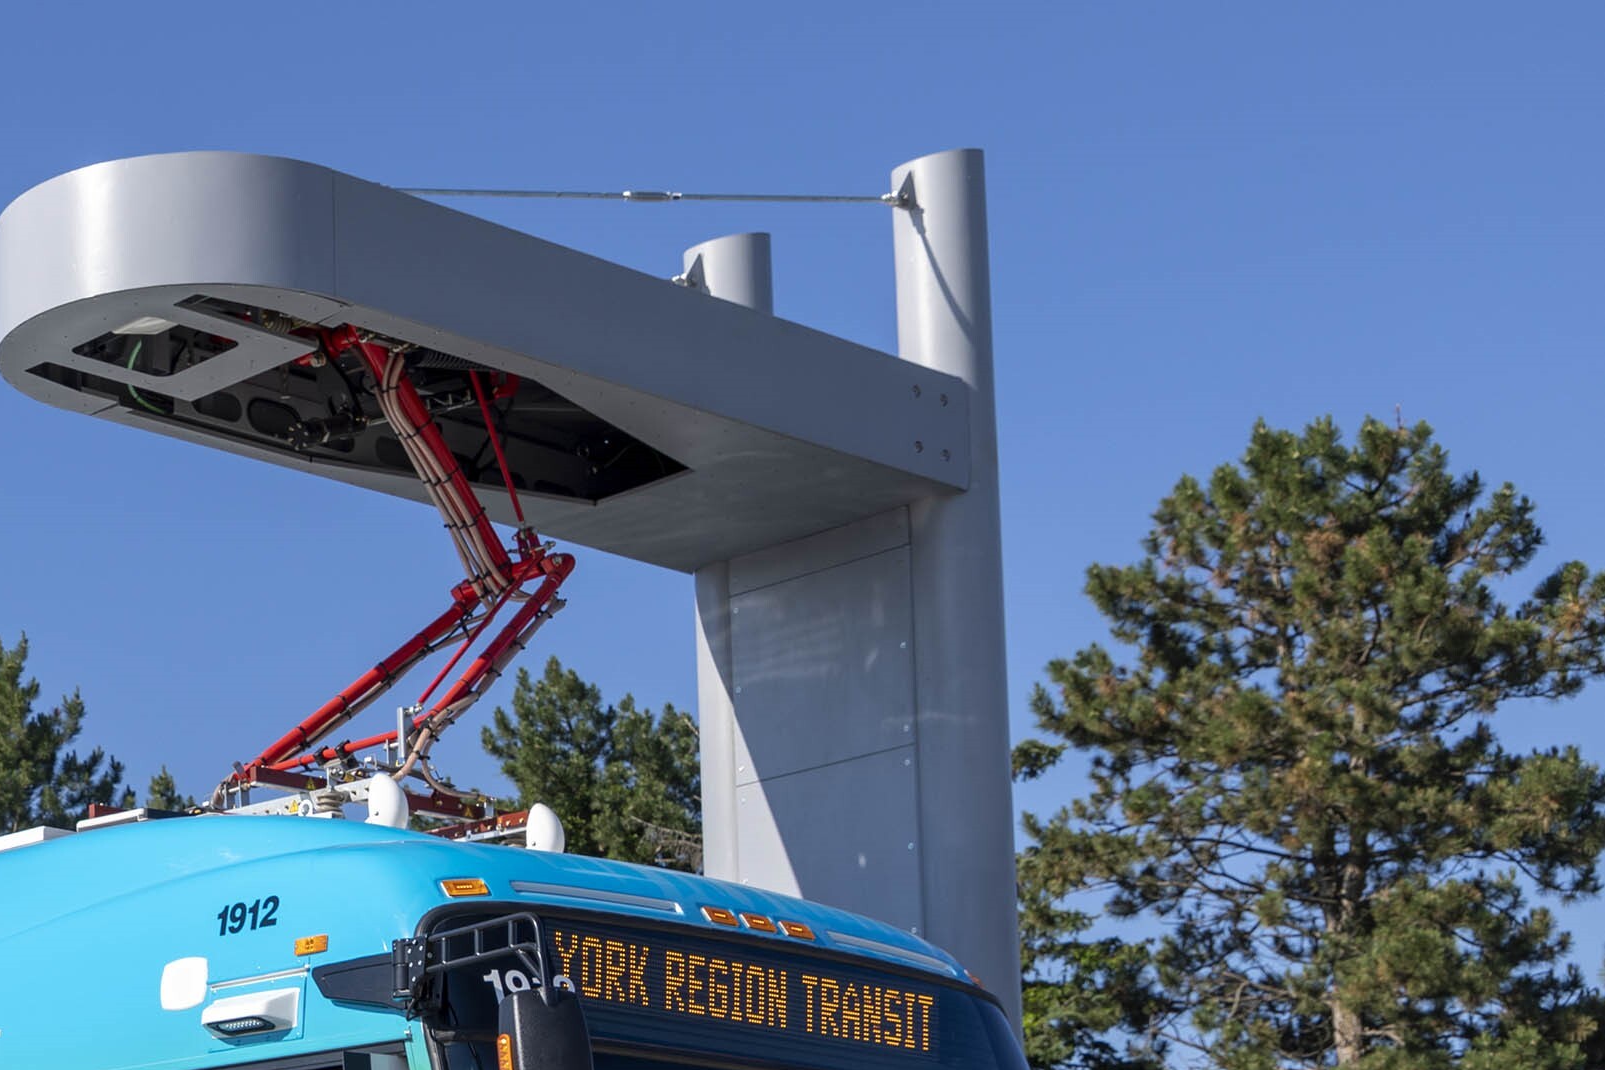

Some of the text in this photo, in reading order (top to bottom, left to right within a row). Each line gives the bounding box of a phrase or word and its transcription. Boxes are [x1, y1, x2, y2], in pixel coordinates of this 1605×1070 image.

[217, 895, 280, 937] 1912
[554, 930, 935, 1052] YORK REGION TRANSIT
